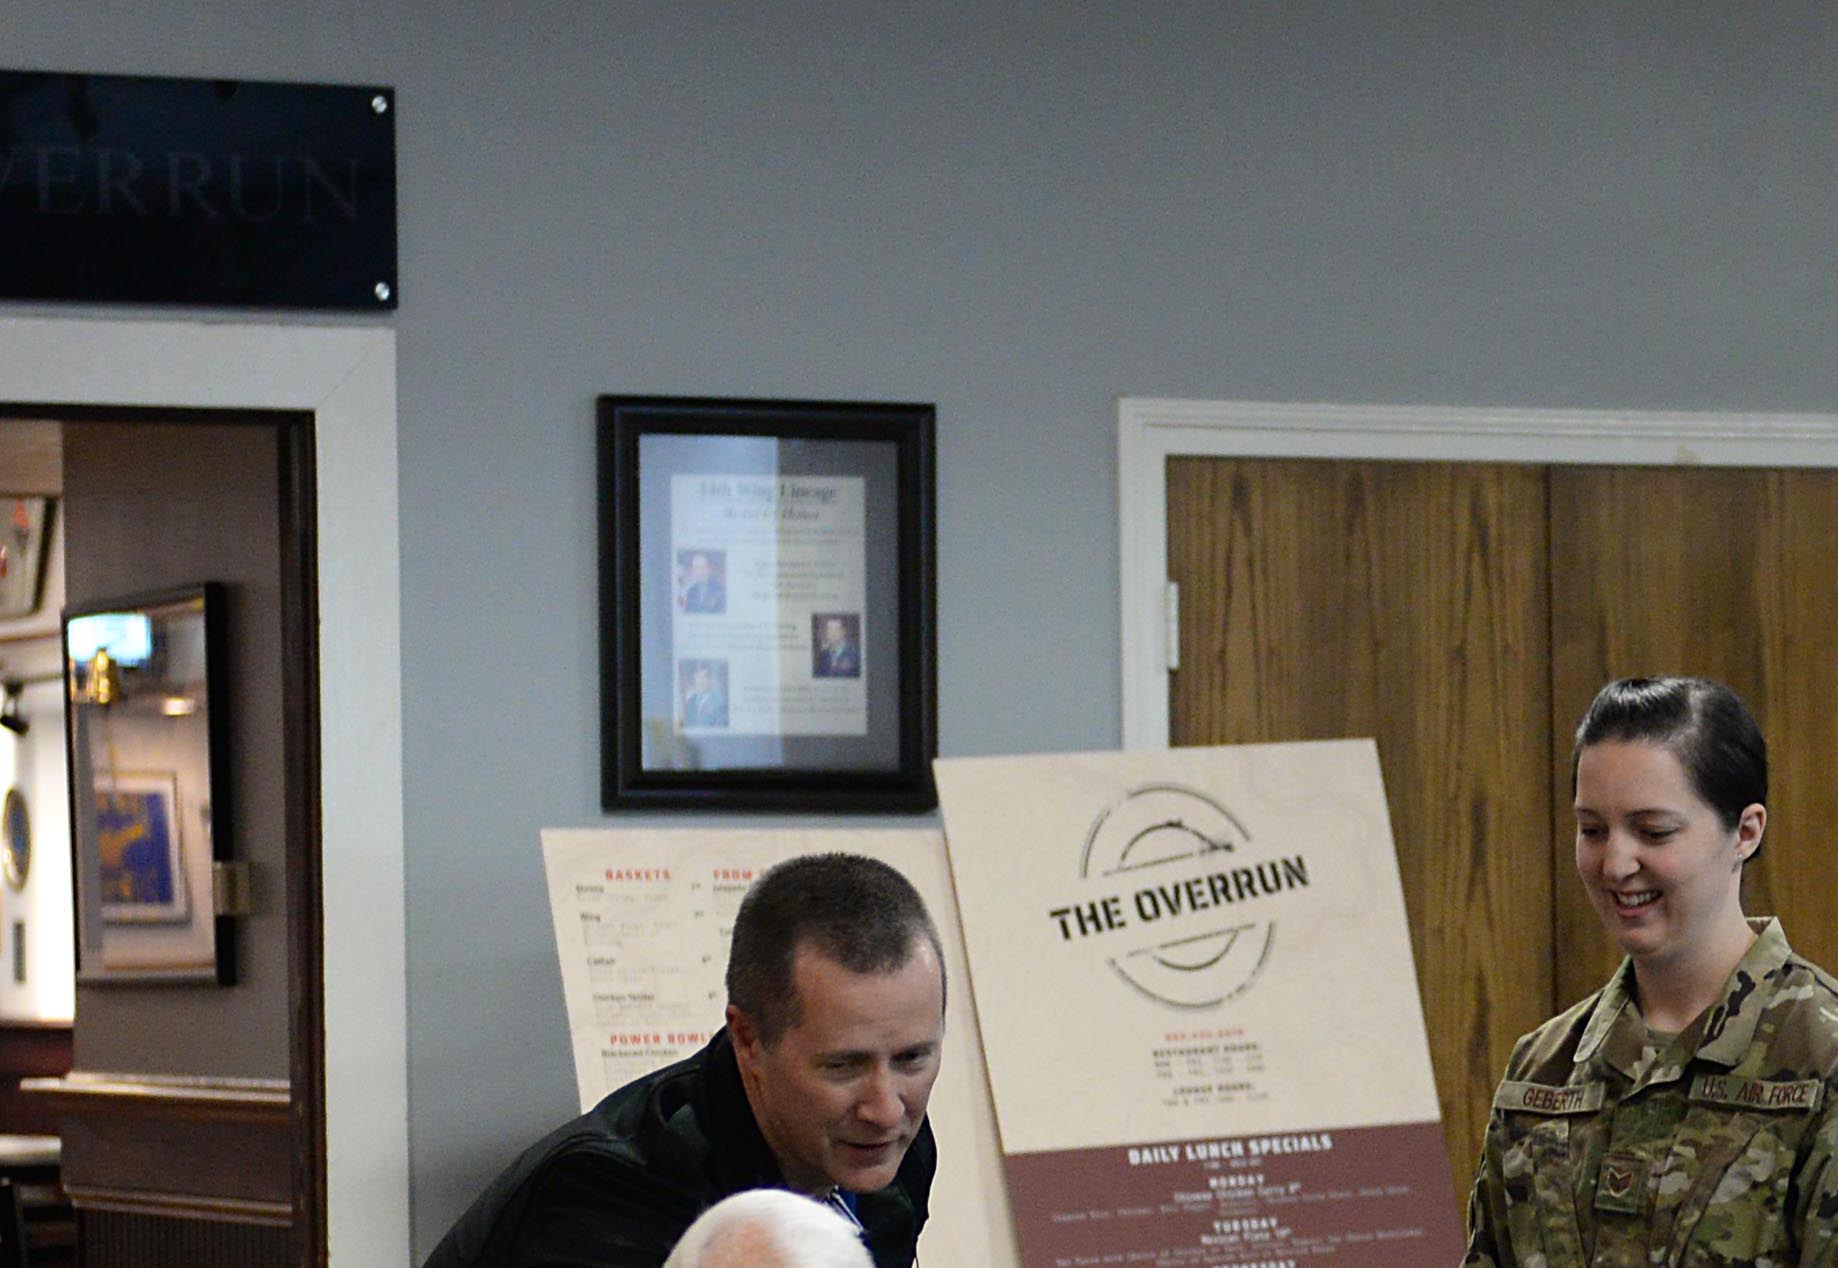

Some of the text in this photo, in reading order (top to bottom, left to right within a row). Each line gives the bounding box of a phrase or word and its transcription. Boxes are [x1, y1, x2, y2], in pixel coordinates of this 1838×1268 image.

[605, 868, 672, 881] BASKETS
[712, 867, 753, 881] FROM
[1049, 854, 1310, 941] THE OVERRUN
[609, 1031, 715, 1047] POWER BOWL
[1523, 1086, 1585, 1111] GEBERTH
[1702, 1075, 1808, 1106] U.S. AIR FORCE
[1127, 1145, 1180, 1166] DAILY
[1184, 1140, 1244, 1161] LUNCH
[1248, 1133, 1333, 1155] SPECIALS
[1208, 1172, 1264, 1189] MONDAY
[1213, 1217, 1278, 1233] TUESDAY
